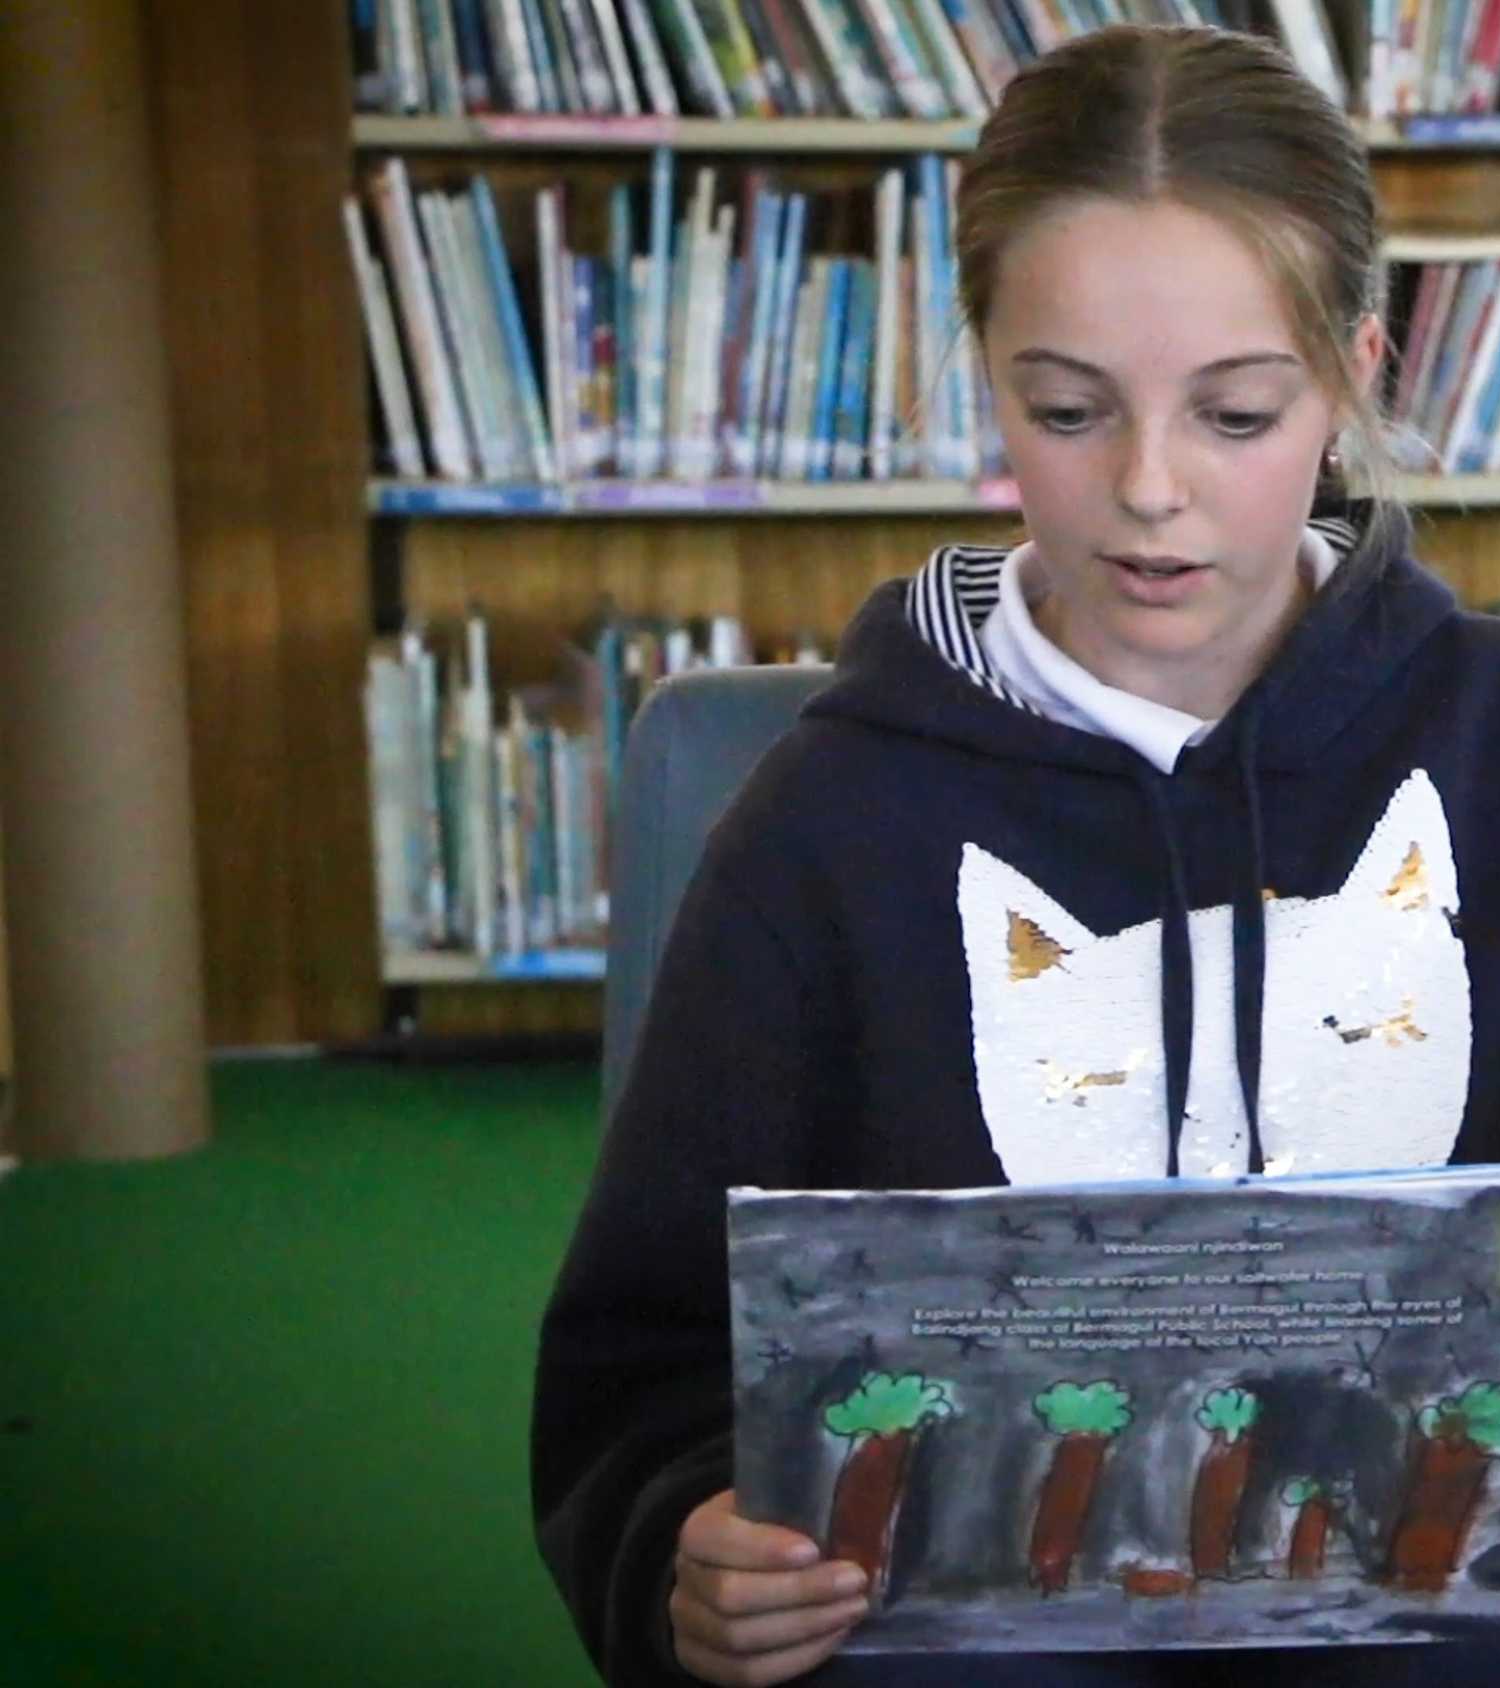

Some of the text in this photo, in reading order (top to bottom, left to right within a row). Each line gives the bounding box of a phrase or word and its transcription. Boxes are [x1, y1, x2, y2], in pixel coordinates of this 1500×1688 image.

[1012, 1275, 1094, 1287] Welcome
[1098, 1274, 1180, 1288] everyone
[1184, 1272, 1200, 1284] to
[1204, 1274, 1231, 1284] our
[1236, 1270, 1310, 1284] saltwater
[914, 1308, 977, 1321] Explore
[981, 1307, 1007, 1318] the
[1012, 1306, 1085, 1318] beautiful
[1089, 1303, 1195, 1317] environment
[1199, 1303, 1216, 1315] of
[1304, 1299, 1367, 1312] through
[1372, 1299, 1398, 1310] the
[1402, 1300, 1441, 1312] eyes
[1445, 1296, 1462, 1308] of
[1006, 1322, 1047, 1333] class
[1052, 1321, 1069, 1333] of
[1158, 1318, 1208, 1331] Public
[1278, 1316, 1320, 1328] while
[1324, 1315, 1393, 1328] learning
[1397, 1315, 1442, 1326] some
[1446, 1312, 1463, 1324] of
[1029, 1338, 1055, 1349] the
[1059, 1337, 1143, 1350] language
[1144, 1336, 1162, 1347] of
[1165, 1335, 1192, 1346] the
[1196, 1333, 1239, 1345] local
